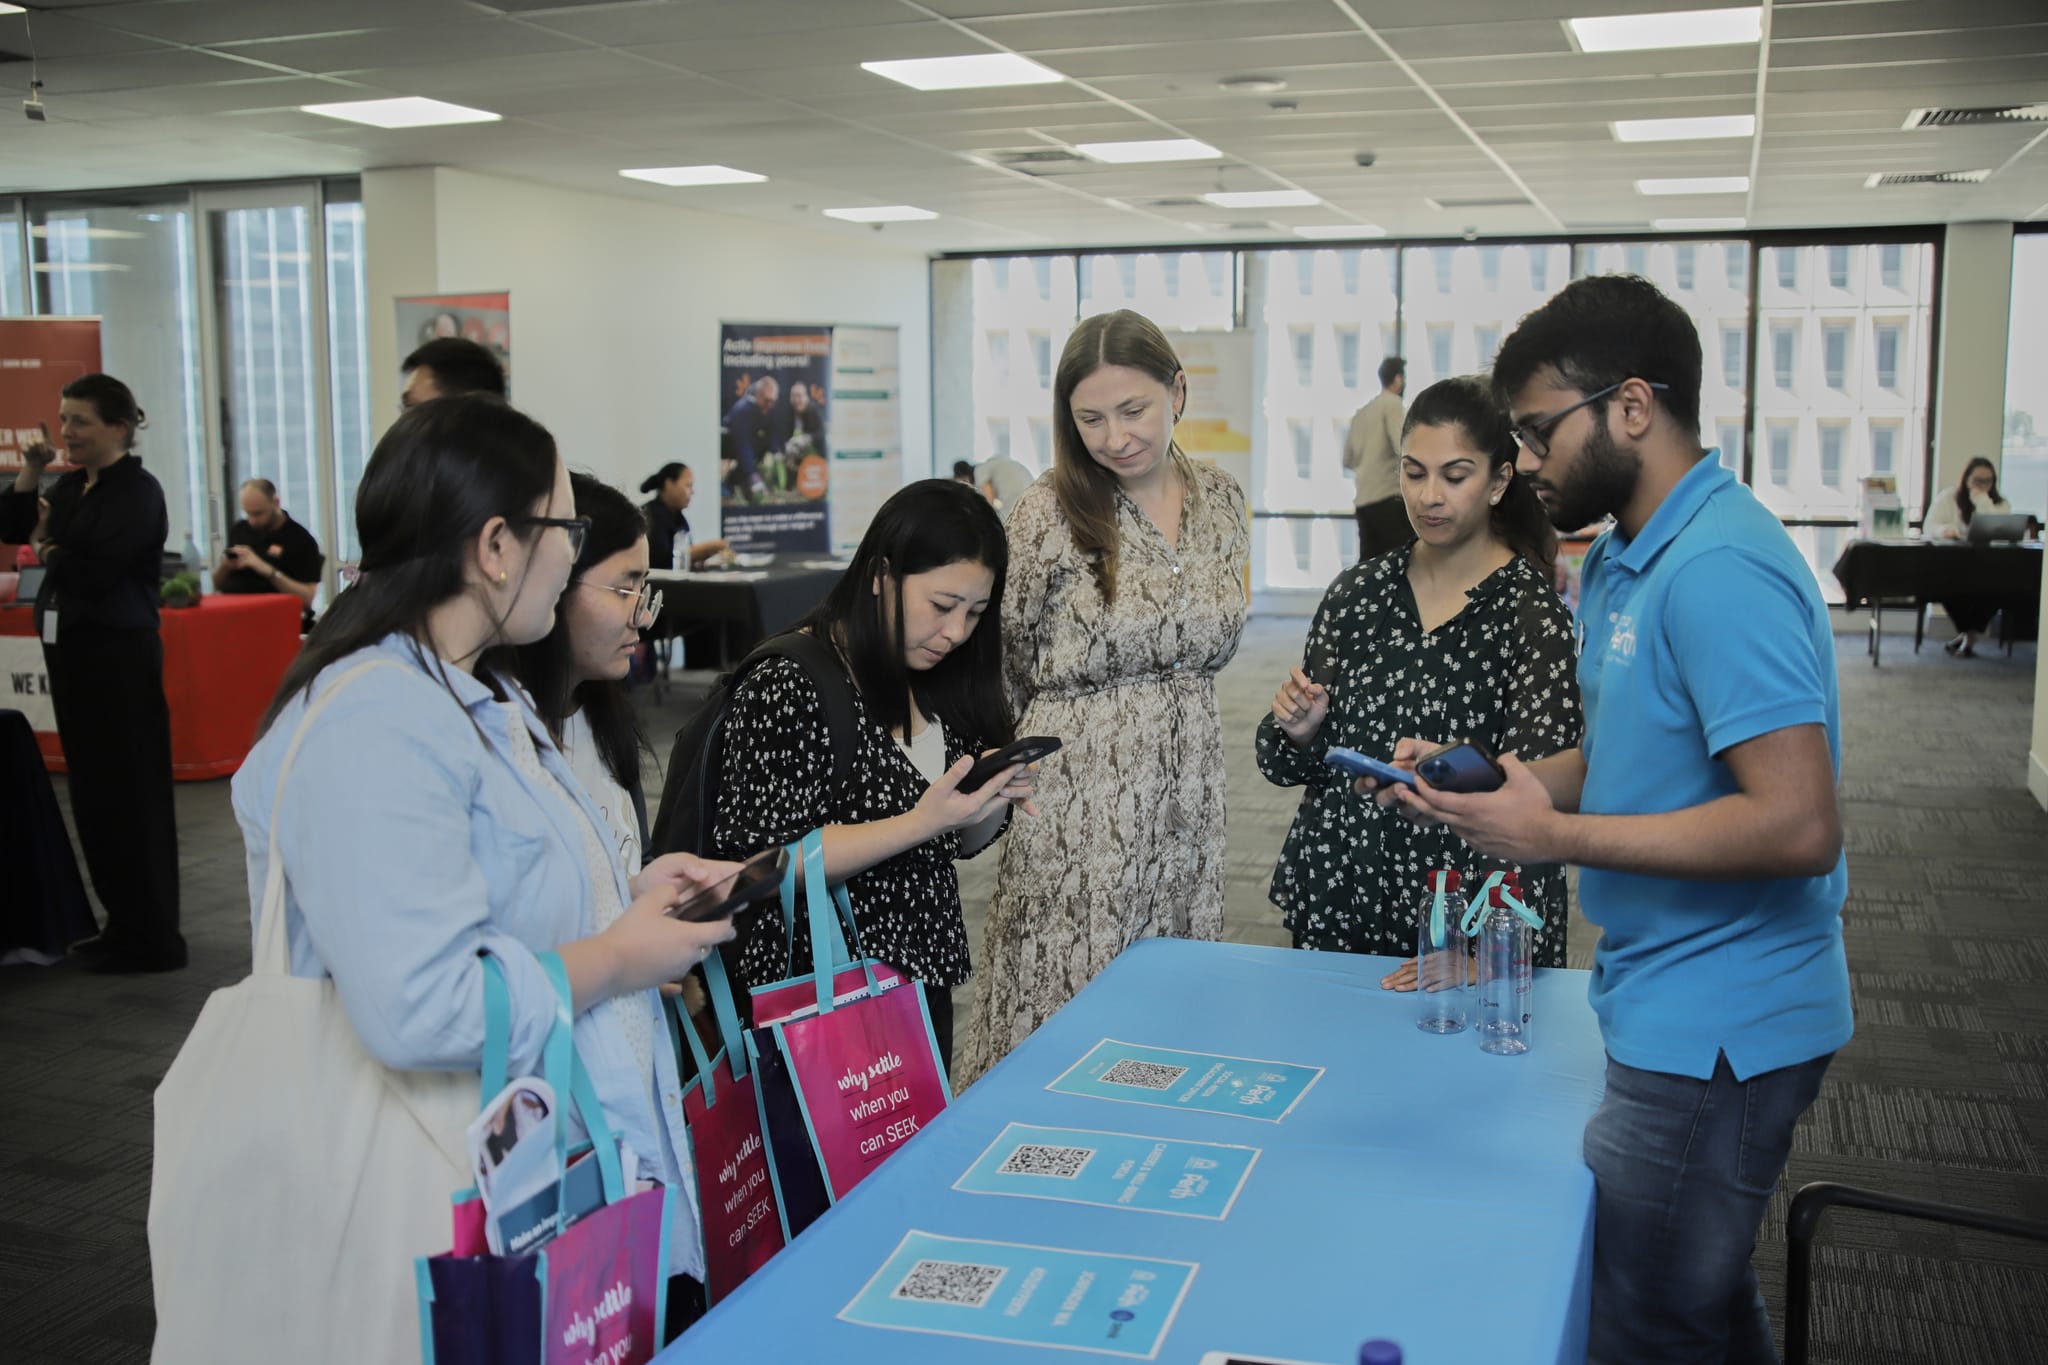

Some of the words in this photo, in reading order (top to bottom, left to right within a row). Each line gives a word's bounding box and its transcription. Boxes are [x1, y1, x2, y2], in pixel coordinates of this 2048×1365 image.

[11, 672, 35, 695] WE
[836, 1068, 869, 1093] why
[866, 1051, 903, 1079] settle
[850, 1092, 888, 1121] when
[886, 1087, 910, 1112] you
[860, 1133, 886, 1155] can
[886, 1115, 920, 1143] SEEK
[718, 1158, 738, 1184] why
[736, 1132, 762, 1167] settle
[724, 1184, 748, 1214] when
[747, 1167, 766, 1195] you
[728, 1225, 748, 1248] can
[746, 1199, 771, 1231] SEEK
[563, 1311, 596, 1348] why
[594, 1280, 632, 1325] settle
[609, 1333, 632, 1365] you
